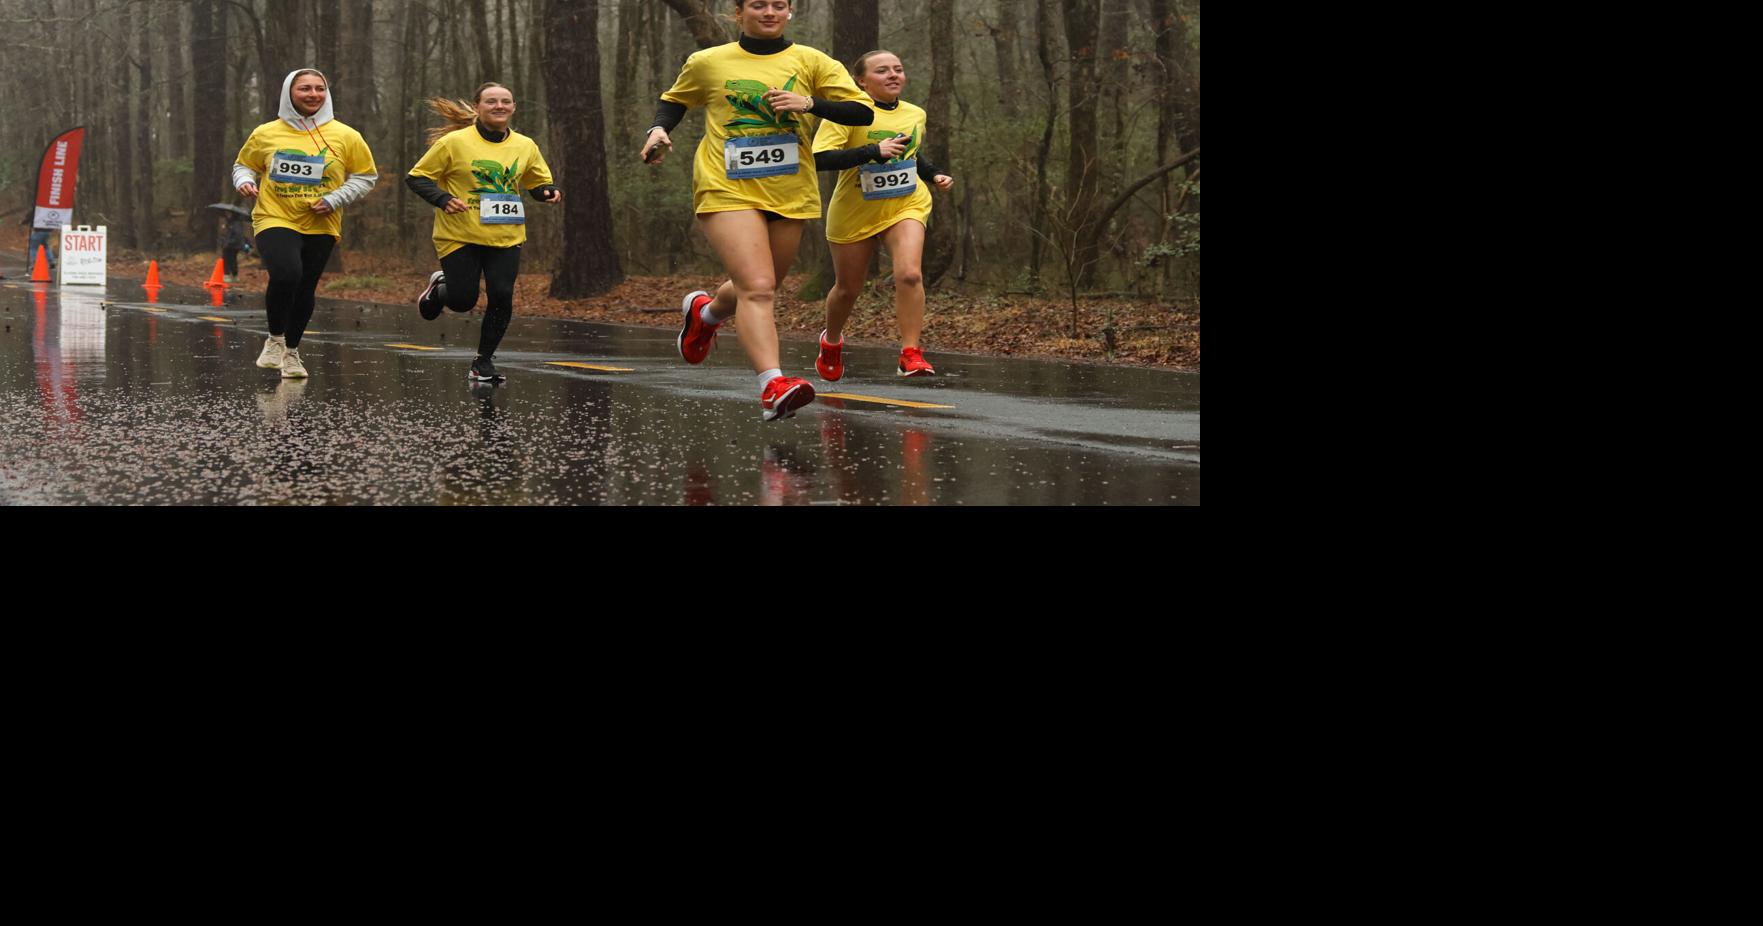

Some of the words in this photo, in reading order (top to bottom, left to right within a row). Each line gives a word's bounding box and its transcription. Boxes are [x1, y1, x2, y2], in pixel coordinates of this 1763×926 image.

[54, 141, 67, 165] LINE
[740, 148, 785, 166] 549
[279, 162, 313, 176] 993
[49, 169, 64, 205] FINISH
[873, 172, 910, 188] 992
[491, 203, 519, 215] 184
[65, 235, 103, 251] START
